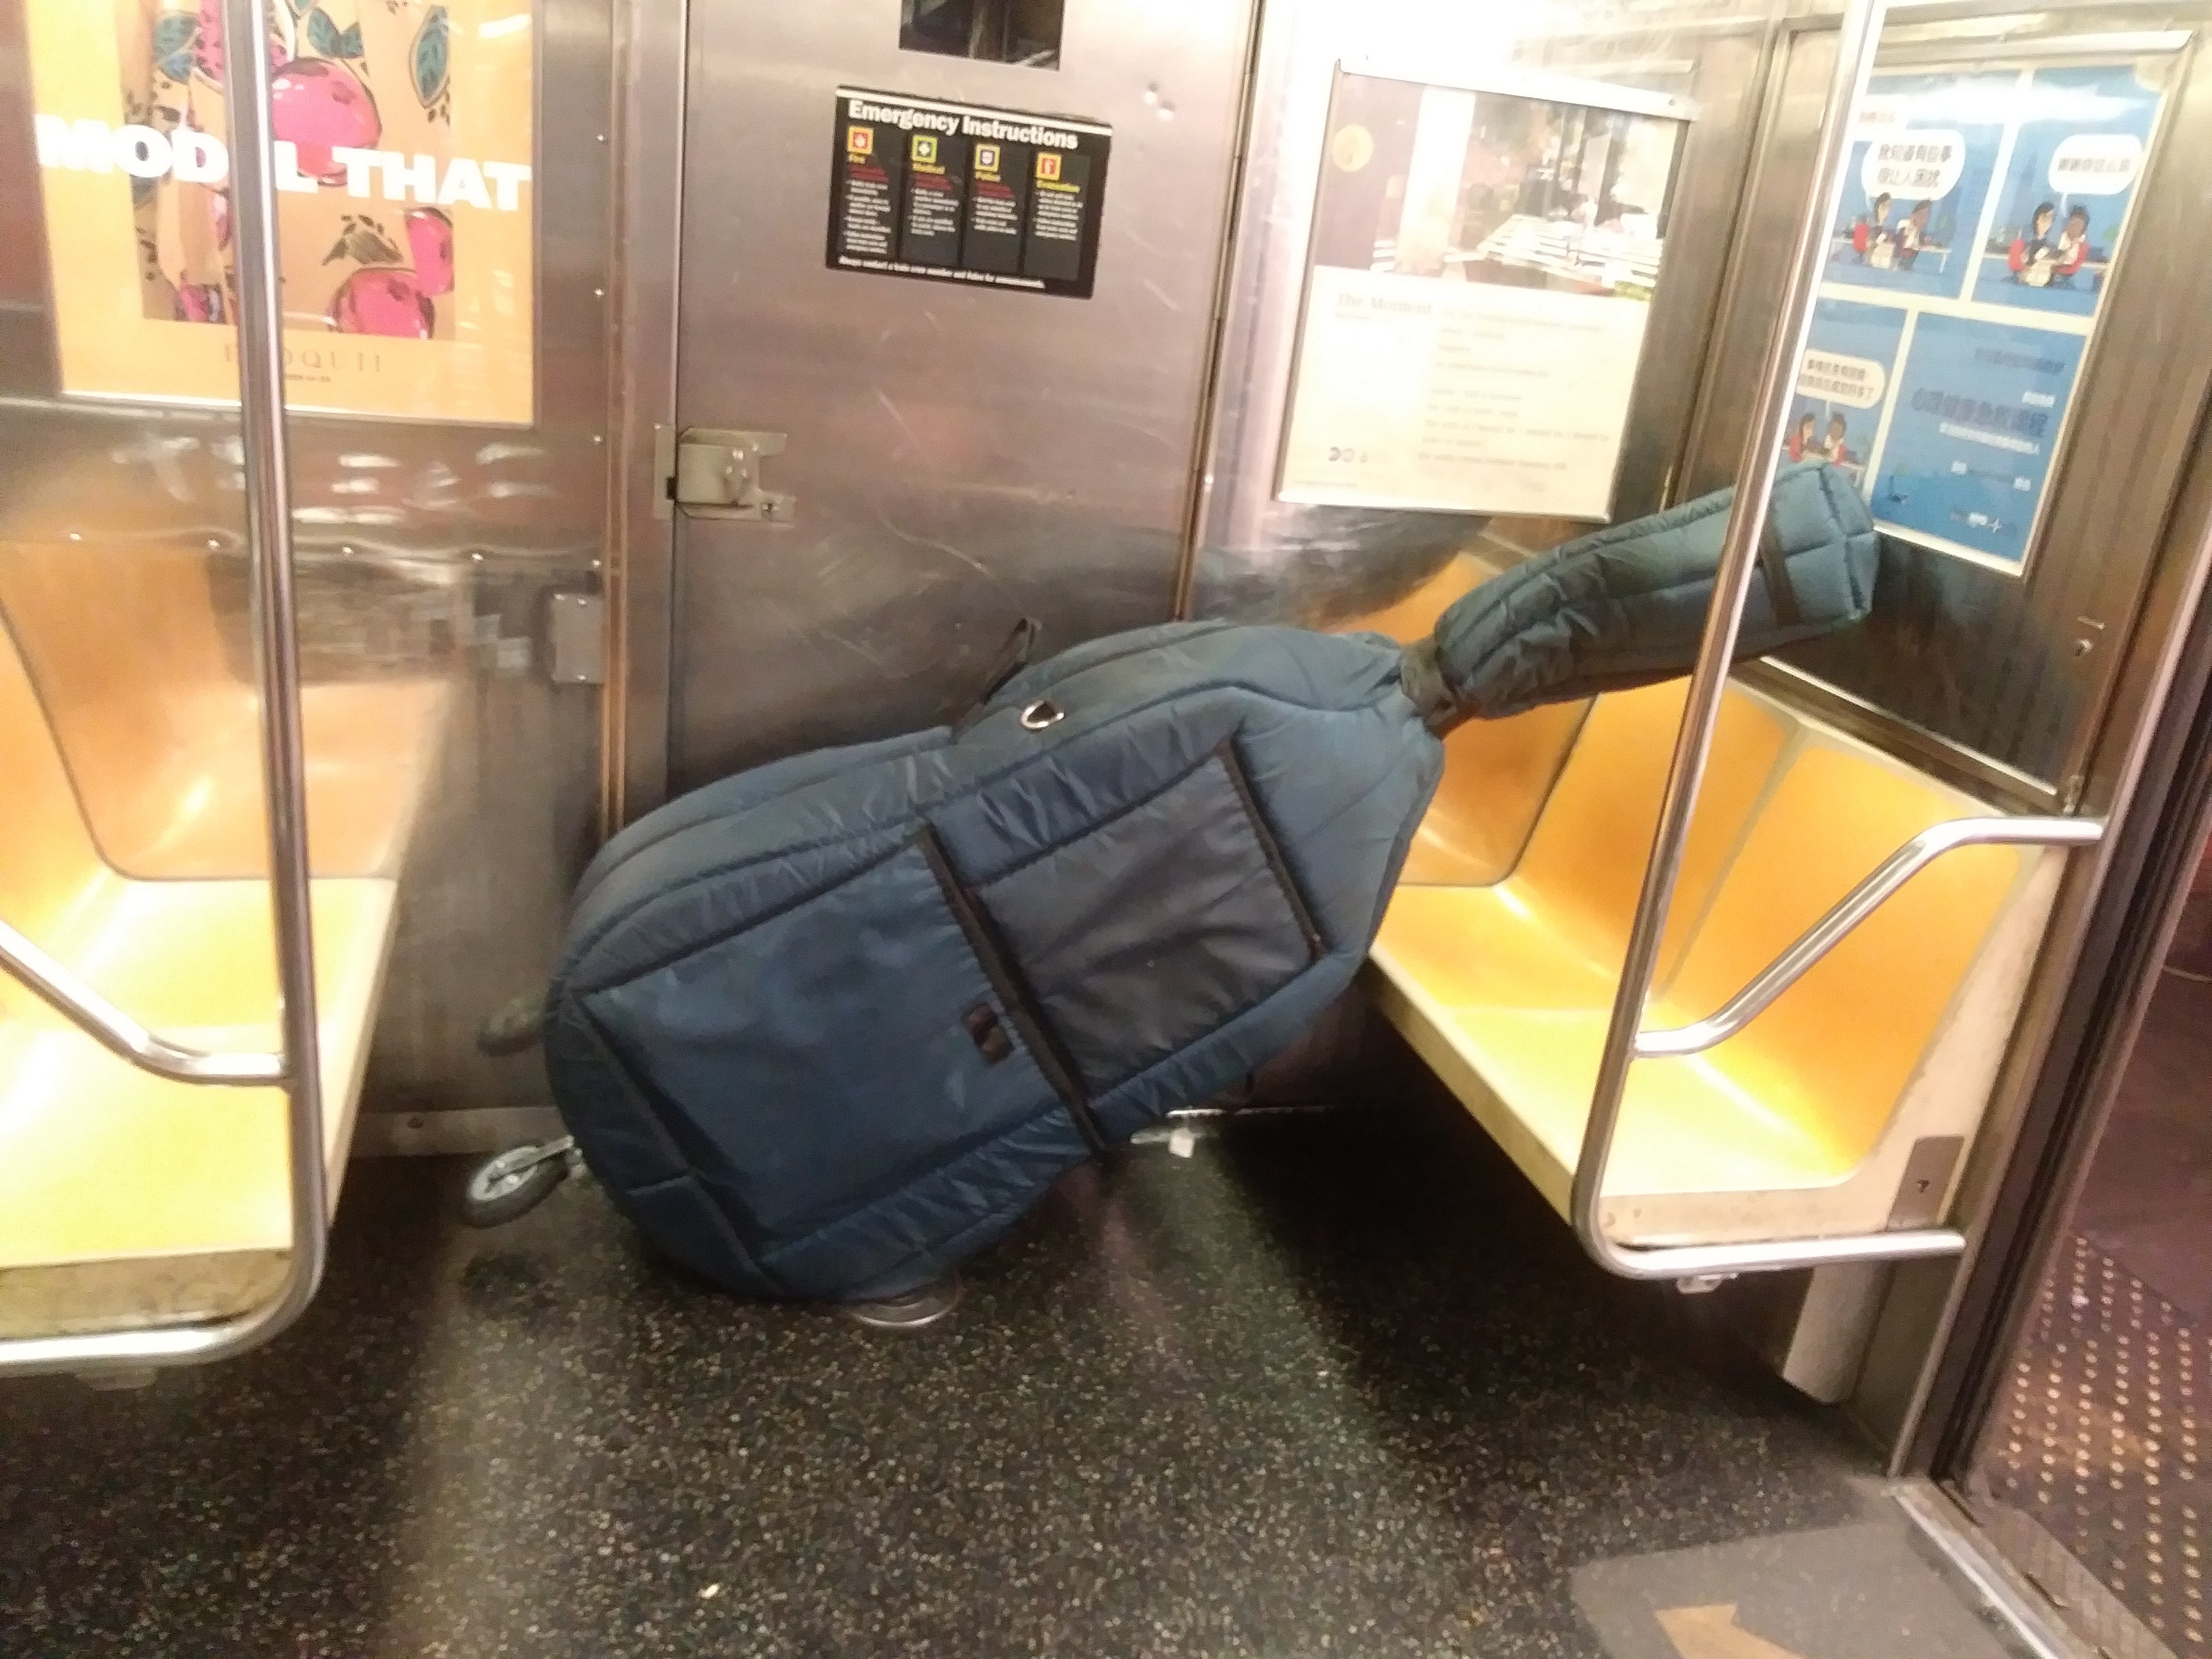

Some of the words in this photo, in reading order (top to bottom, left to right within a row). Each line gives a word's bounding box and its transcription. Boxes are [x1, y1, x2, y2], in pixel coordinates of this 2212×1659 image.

[849, 99, 960, 135] Emergency
[962, 115, 1078, 149] Instructions
[34, 114, 317, 192] MODL
[331, 147, 531, 211] THAT
